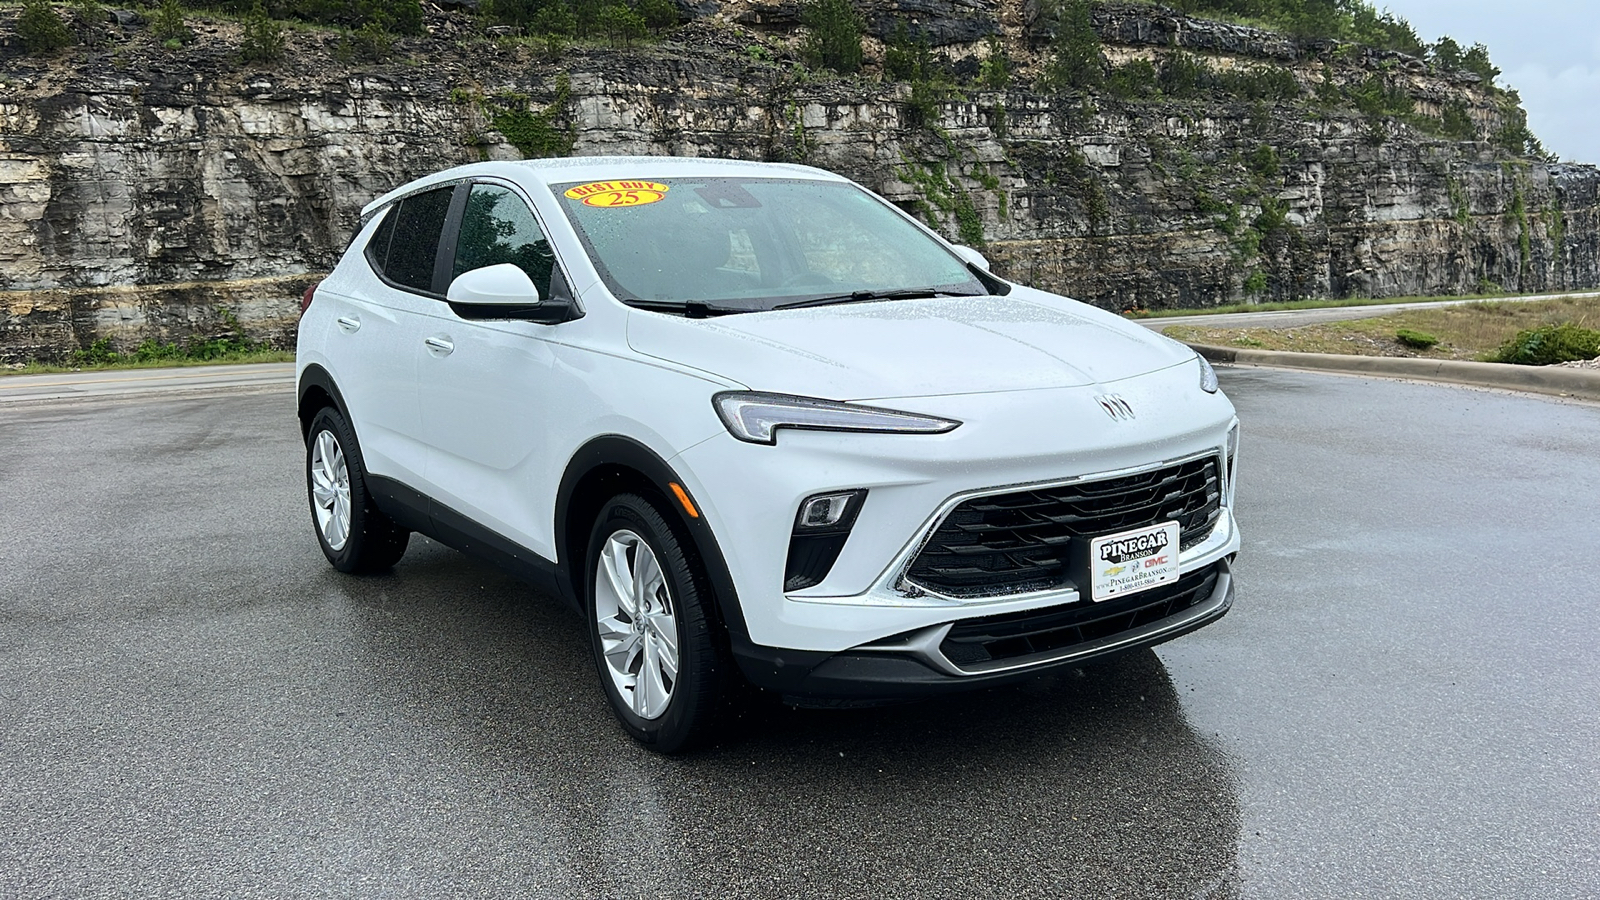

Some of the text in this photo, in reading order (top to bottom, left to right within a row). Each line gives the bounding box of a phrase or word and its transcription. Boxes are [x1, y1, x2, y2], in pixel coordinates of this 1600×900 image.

[571, 181, 655, 196] BEST BUY
[608, 190, 640, 206] 25
[1101, 532, 1168, 559] PINEGAR
[1120, 549, 1153, 562] BRANSON
[1144, 555, 1168, 569] GMC
